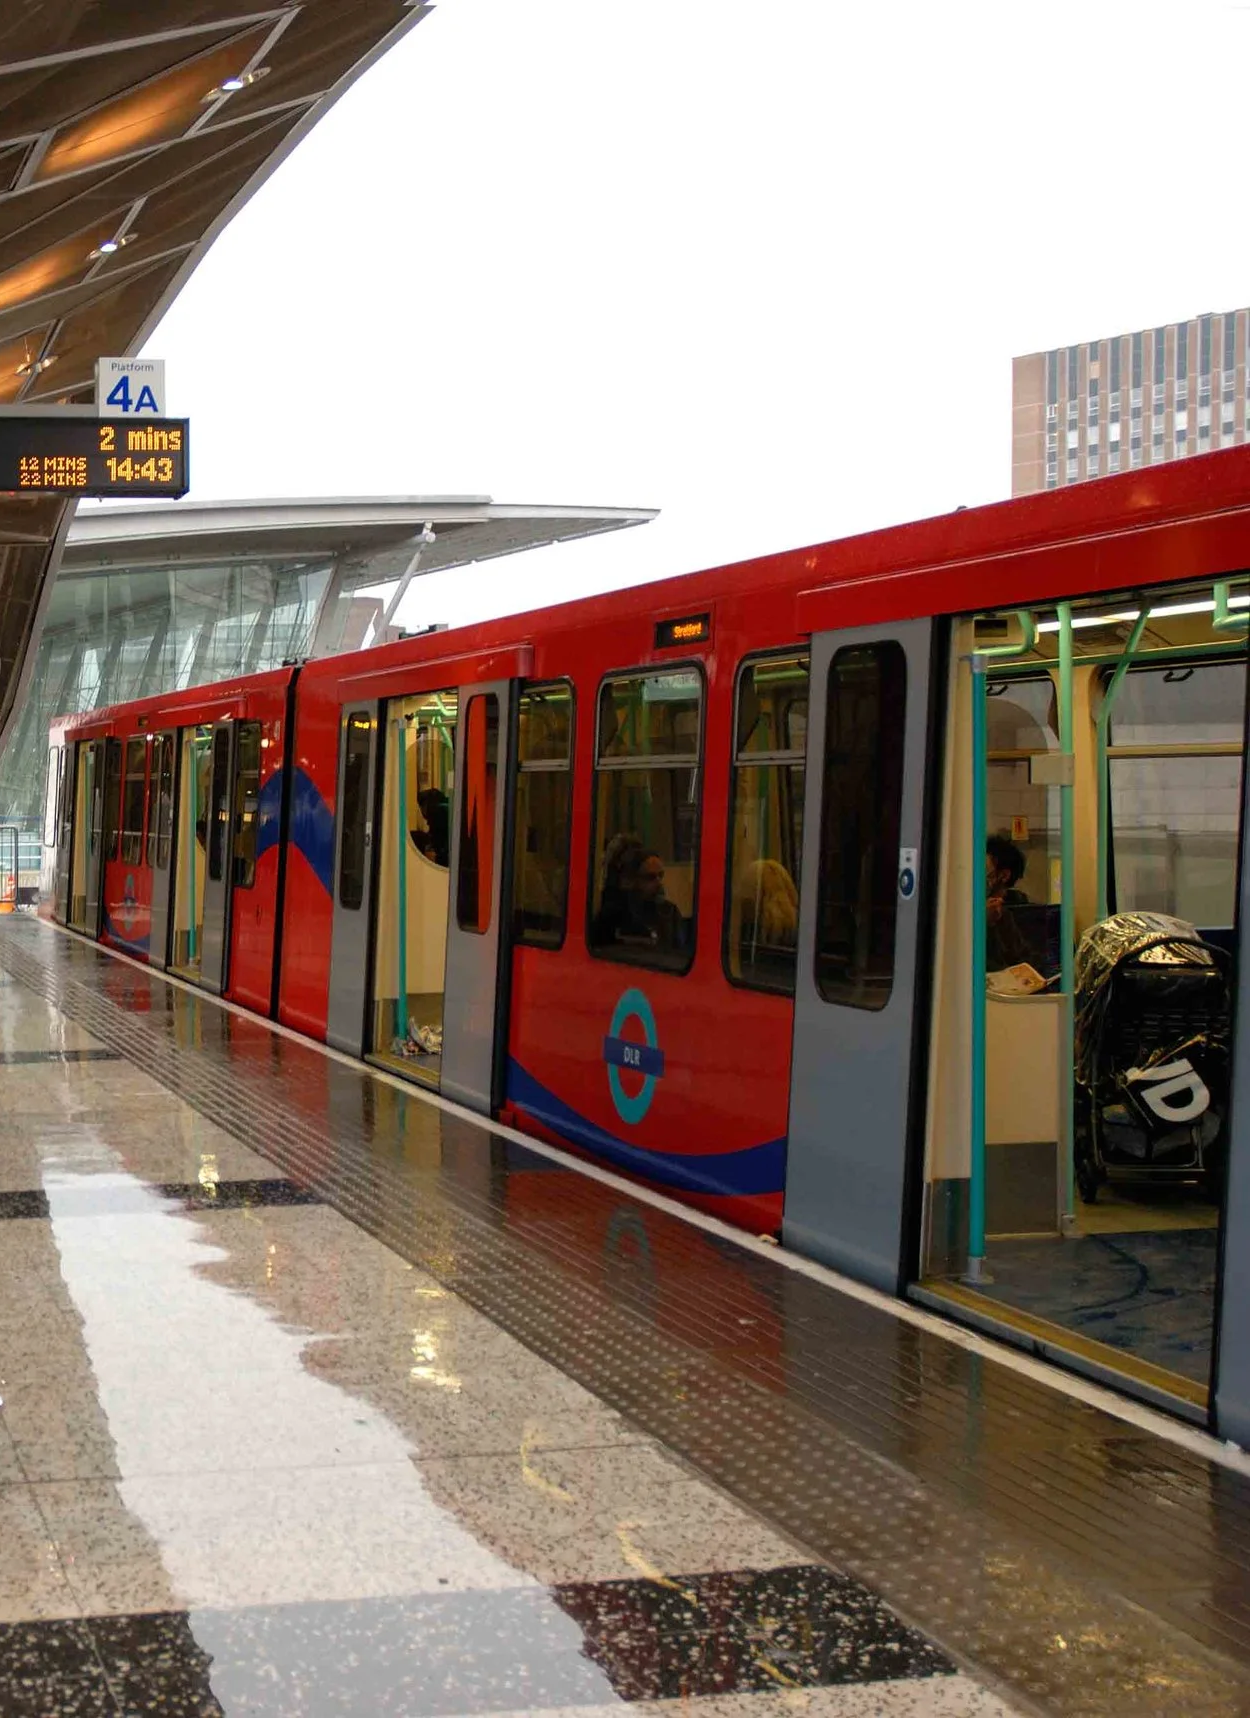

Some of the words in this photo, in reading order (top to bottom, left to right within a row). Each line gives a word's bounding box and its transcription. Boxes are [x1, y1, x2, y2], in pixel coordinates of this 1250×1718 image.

[111, 363, 154, 372] Platform
[106, 375, 159, 413] 4A
[100, 427, 115, 450] 2
[128, 427, 181, 451] mins
[19, 457, 40, 471] 12
[44, 457, 87, 471] MINS
[107, 457, 172, 481] 14:43
[20, 472, 41, 486] 22
[44, 472, 87, 486] MINS
[624, 1046, 640, 1065] DLR
